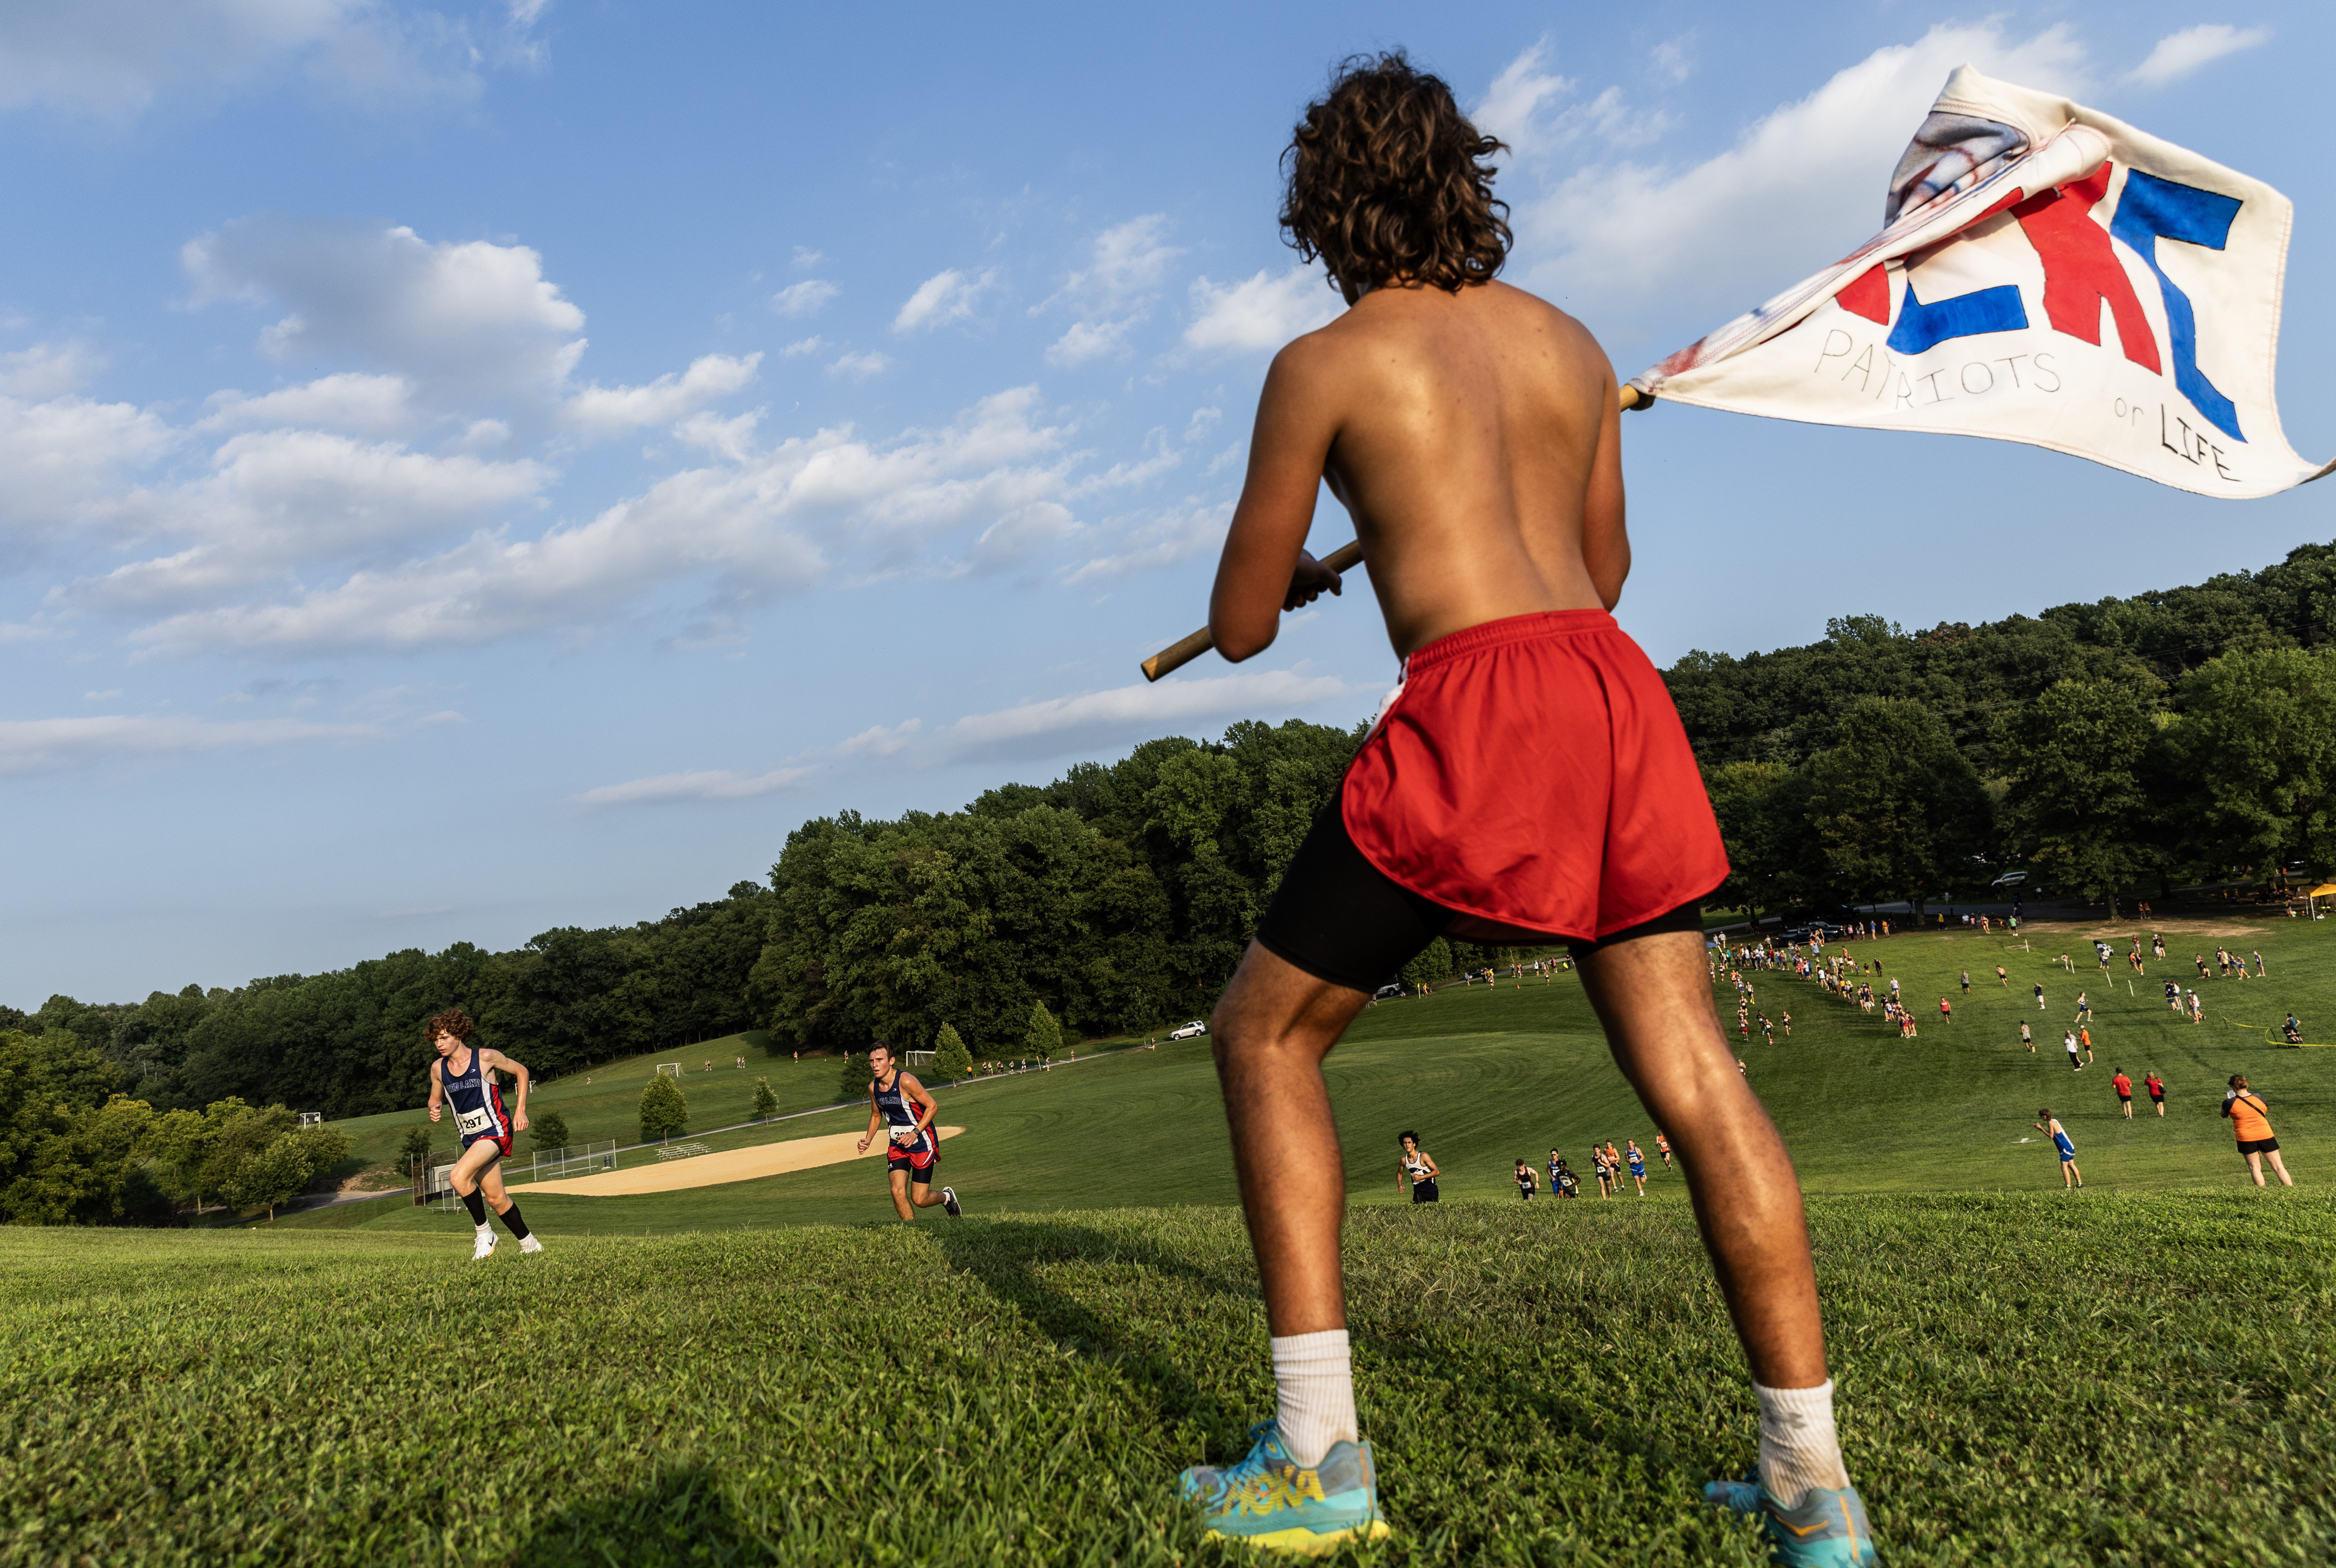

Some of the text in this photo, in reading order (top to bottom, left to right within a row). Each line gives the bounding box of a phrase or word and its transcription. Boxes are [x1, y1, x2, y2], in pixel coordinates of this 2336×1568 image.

[1815, 329, 2242, 482] PATRIOTS or LIFE
[460, 1079, 481, 1089] LAND
[463, 1116, 481, 1128] 297
[1222, 1465, 1326, 1518] HOKA
